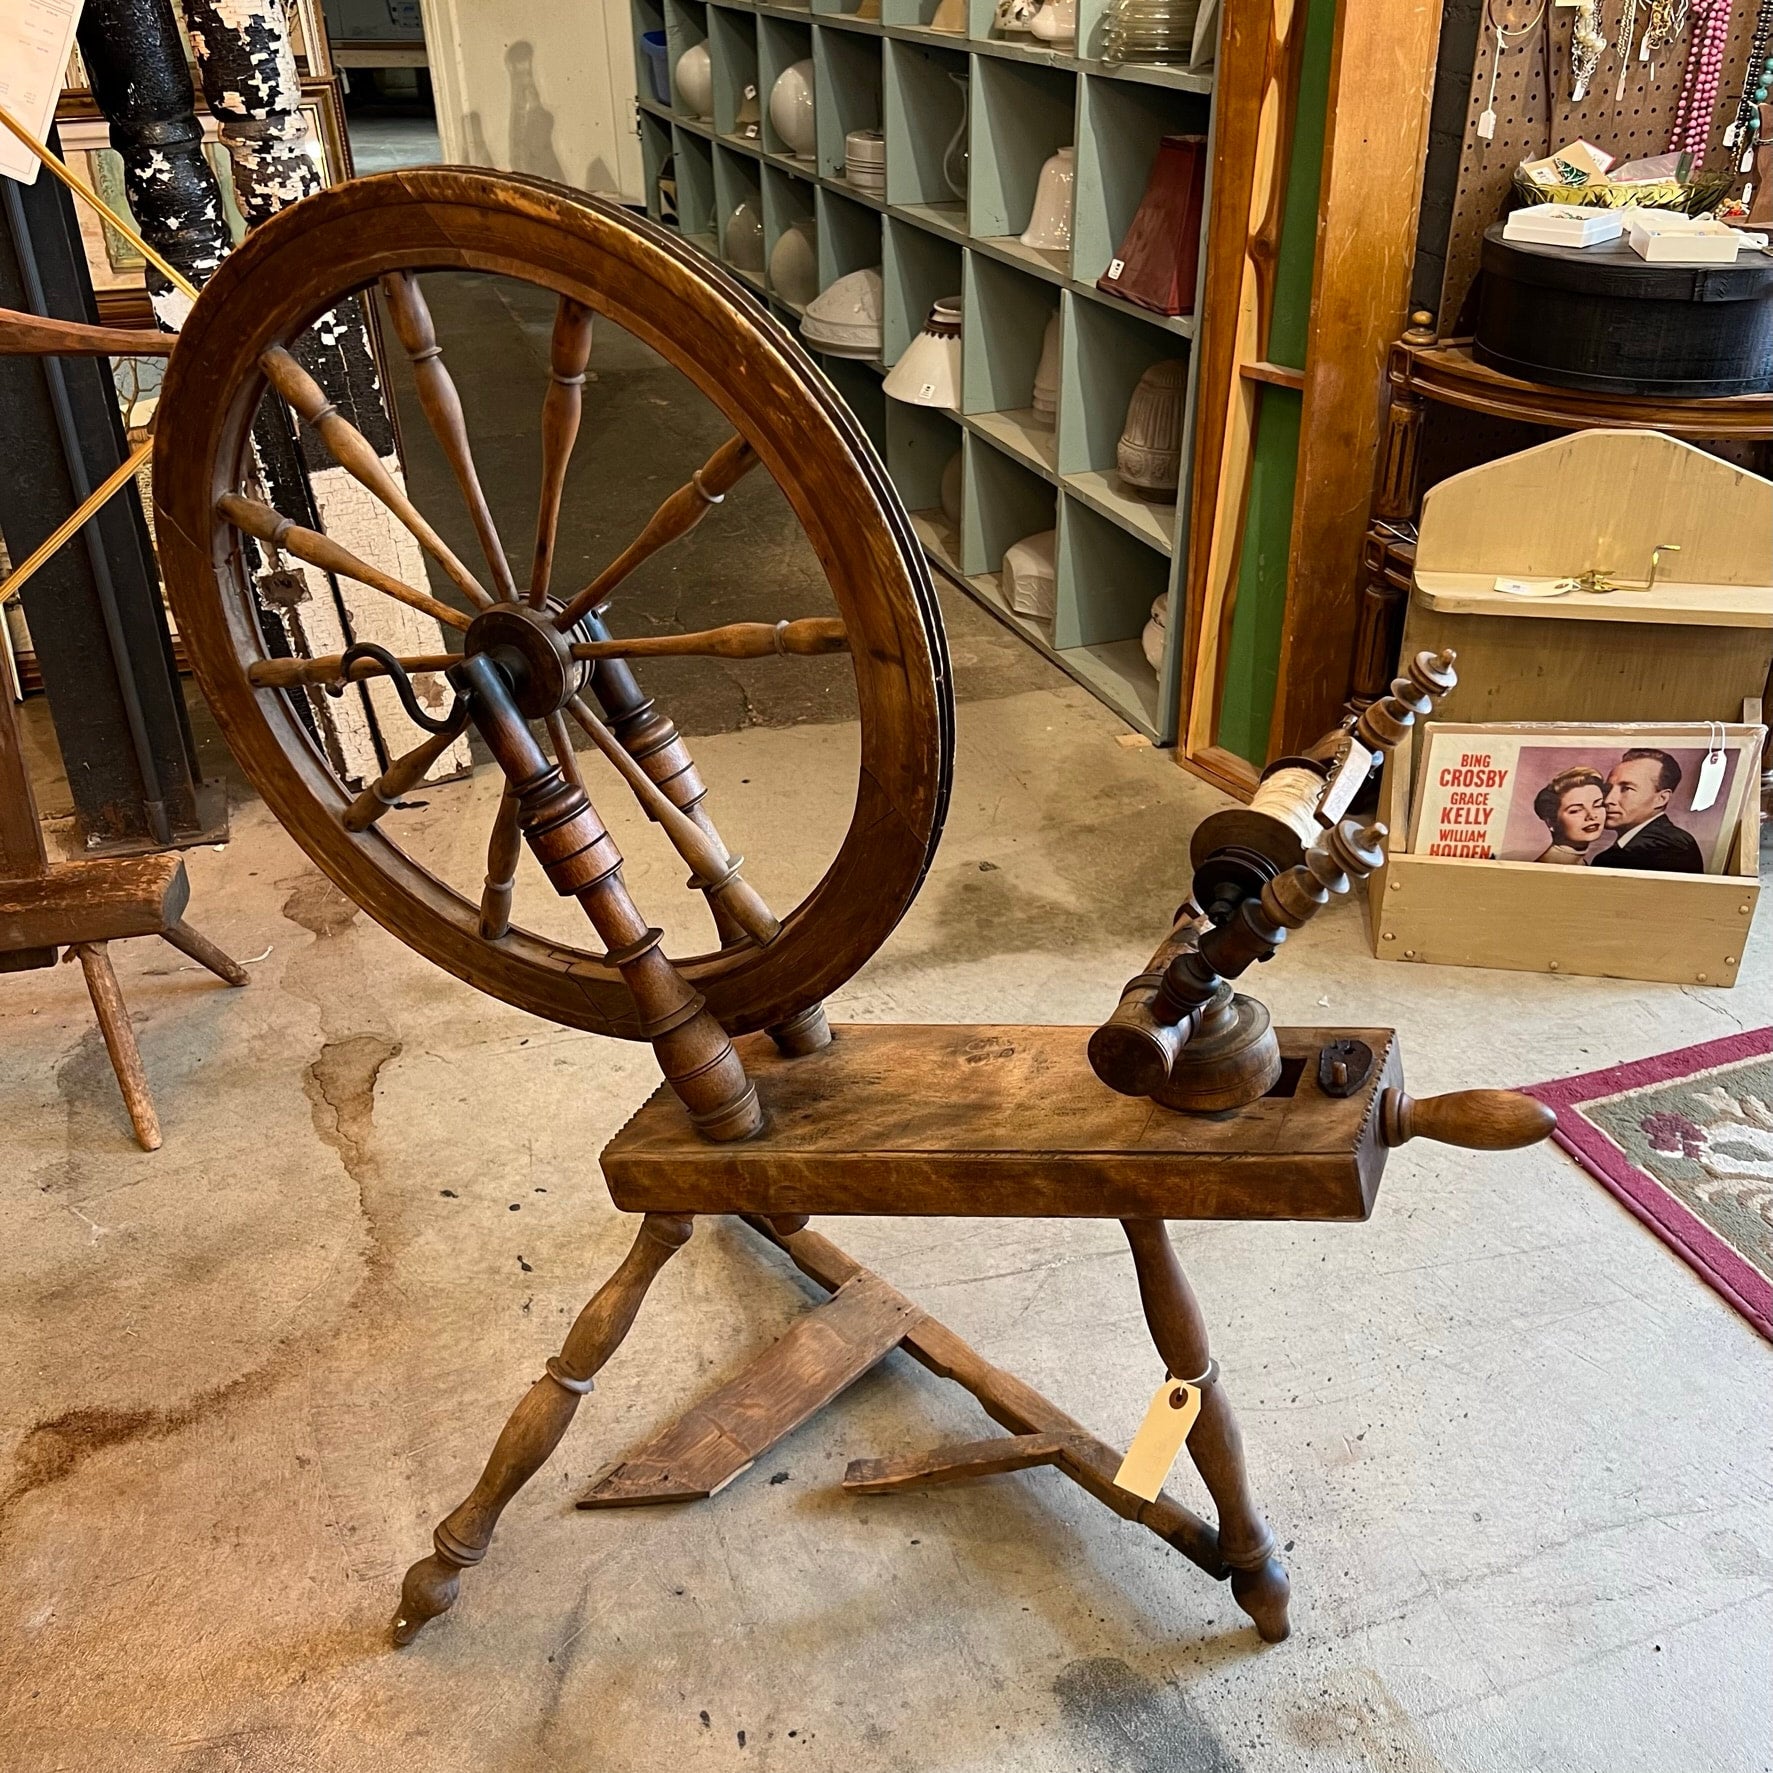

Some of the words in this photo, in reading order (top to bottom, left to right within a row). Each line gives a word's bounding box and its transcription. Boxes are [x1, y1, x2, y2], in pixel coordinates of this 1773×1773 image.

[1461, 754, 1491, 768] BING
[1439, 768, 1508, 788] CROSBY
[1450, 792, 1490, 806] GRACE
[1440, 807, 1494, 825] KELLY
[1439, 829, 1487, 843] WILLIAM
